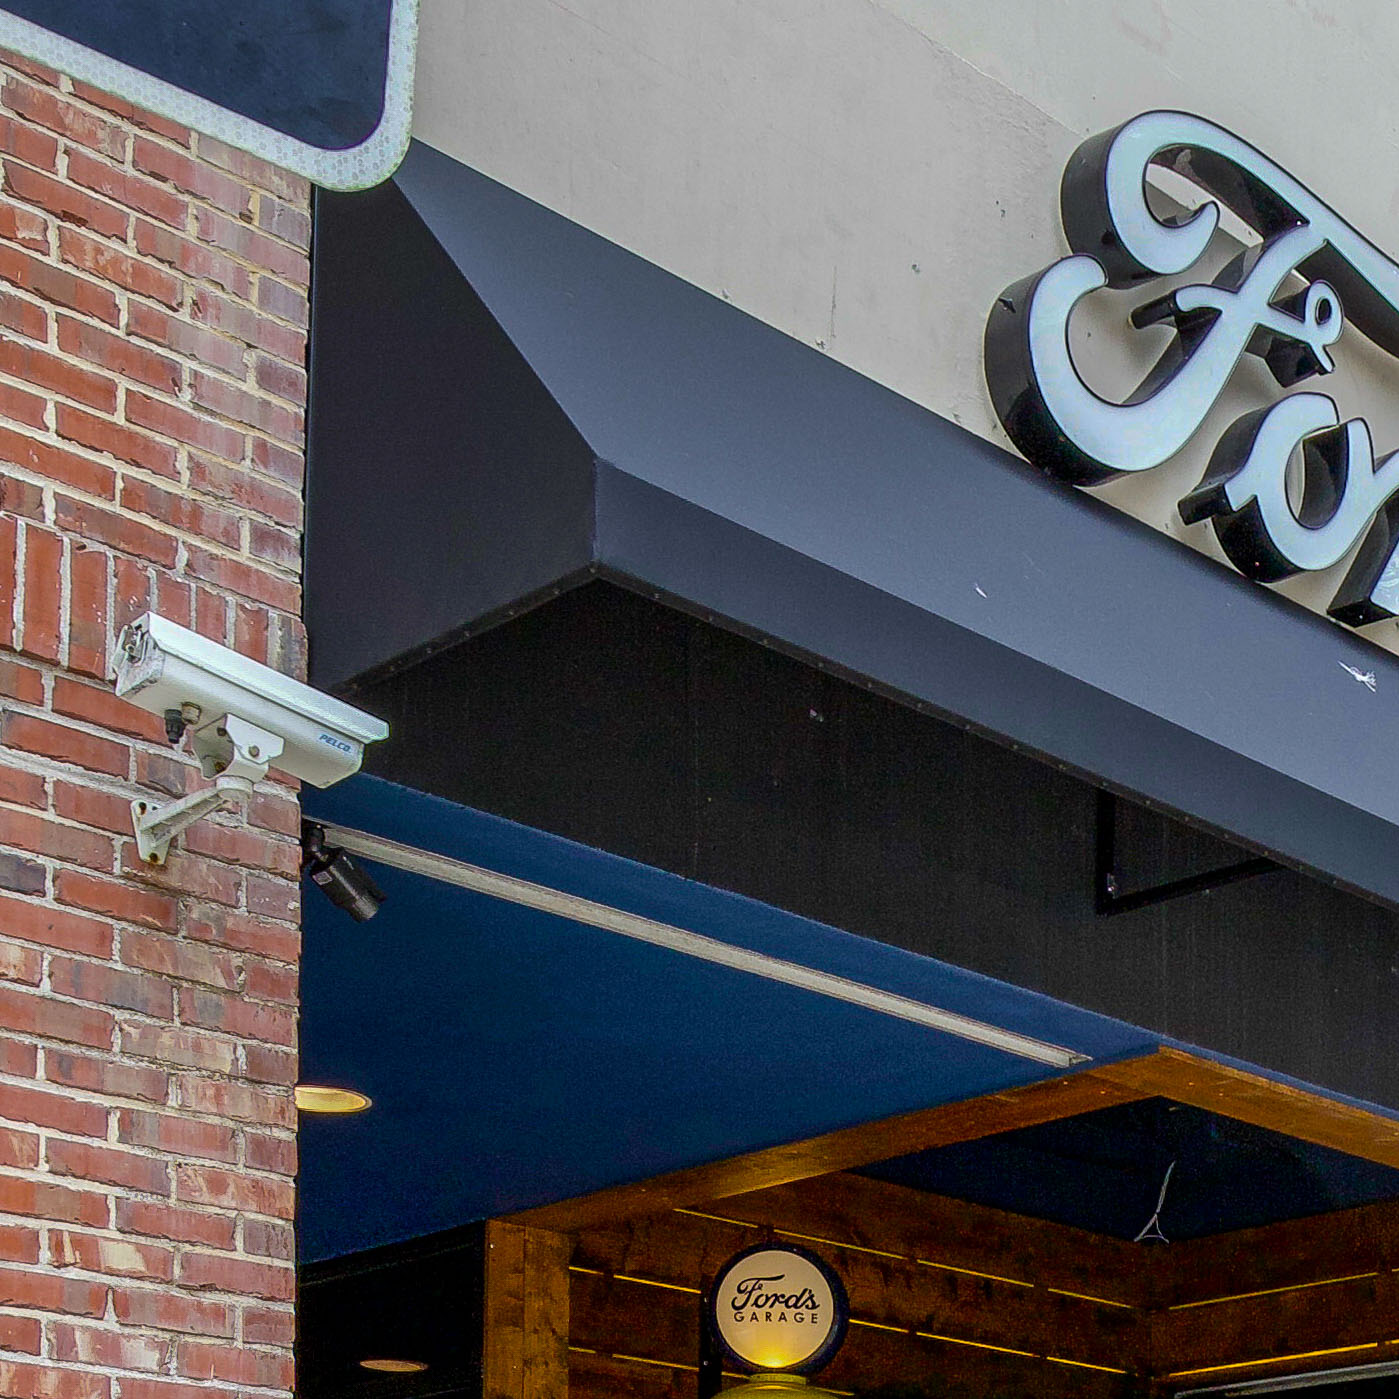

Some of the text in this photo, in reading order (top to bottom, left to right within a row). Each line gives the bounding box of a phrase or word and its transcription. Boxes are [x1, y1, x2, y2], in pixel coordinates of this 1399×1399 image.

[319, 733, 352, 753] PELCO
[731, 1273, 821, 1311] Ford's
[733, 1310, 819, 1325] GARAGE
